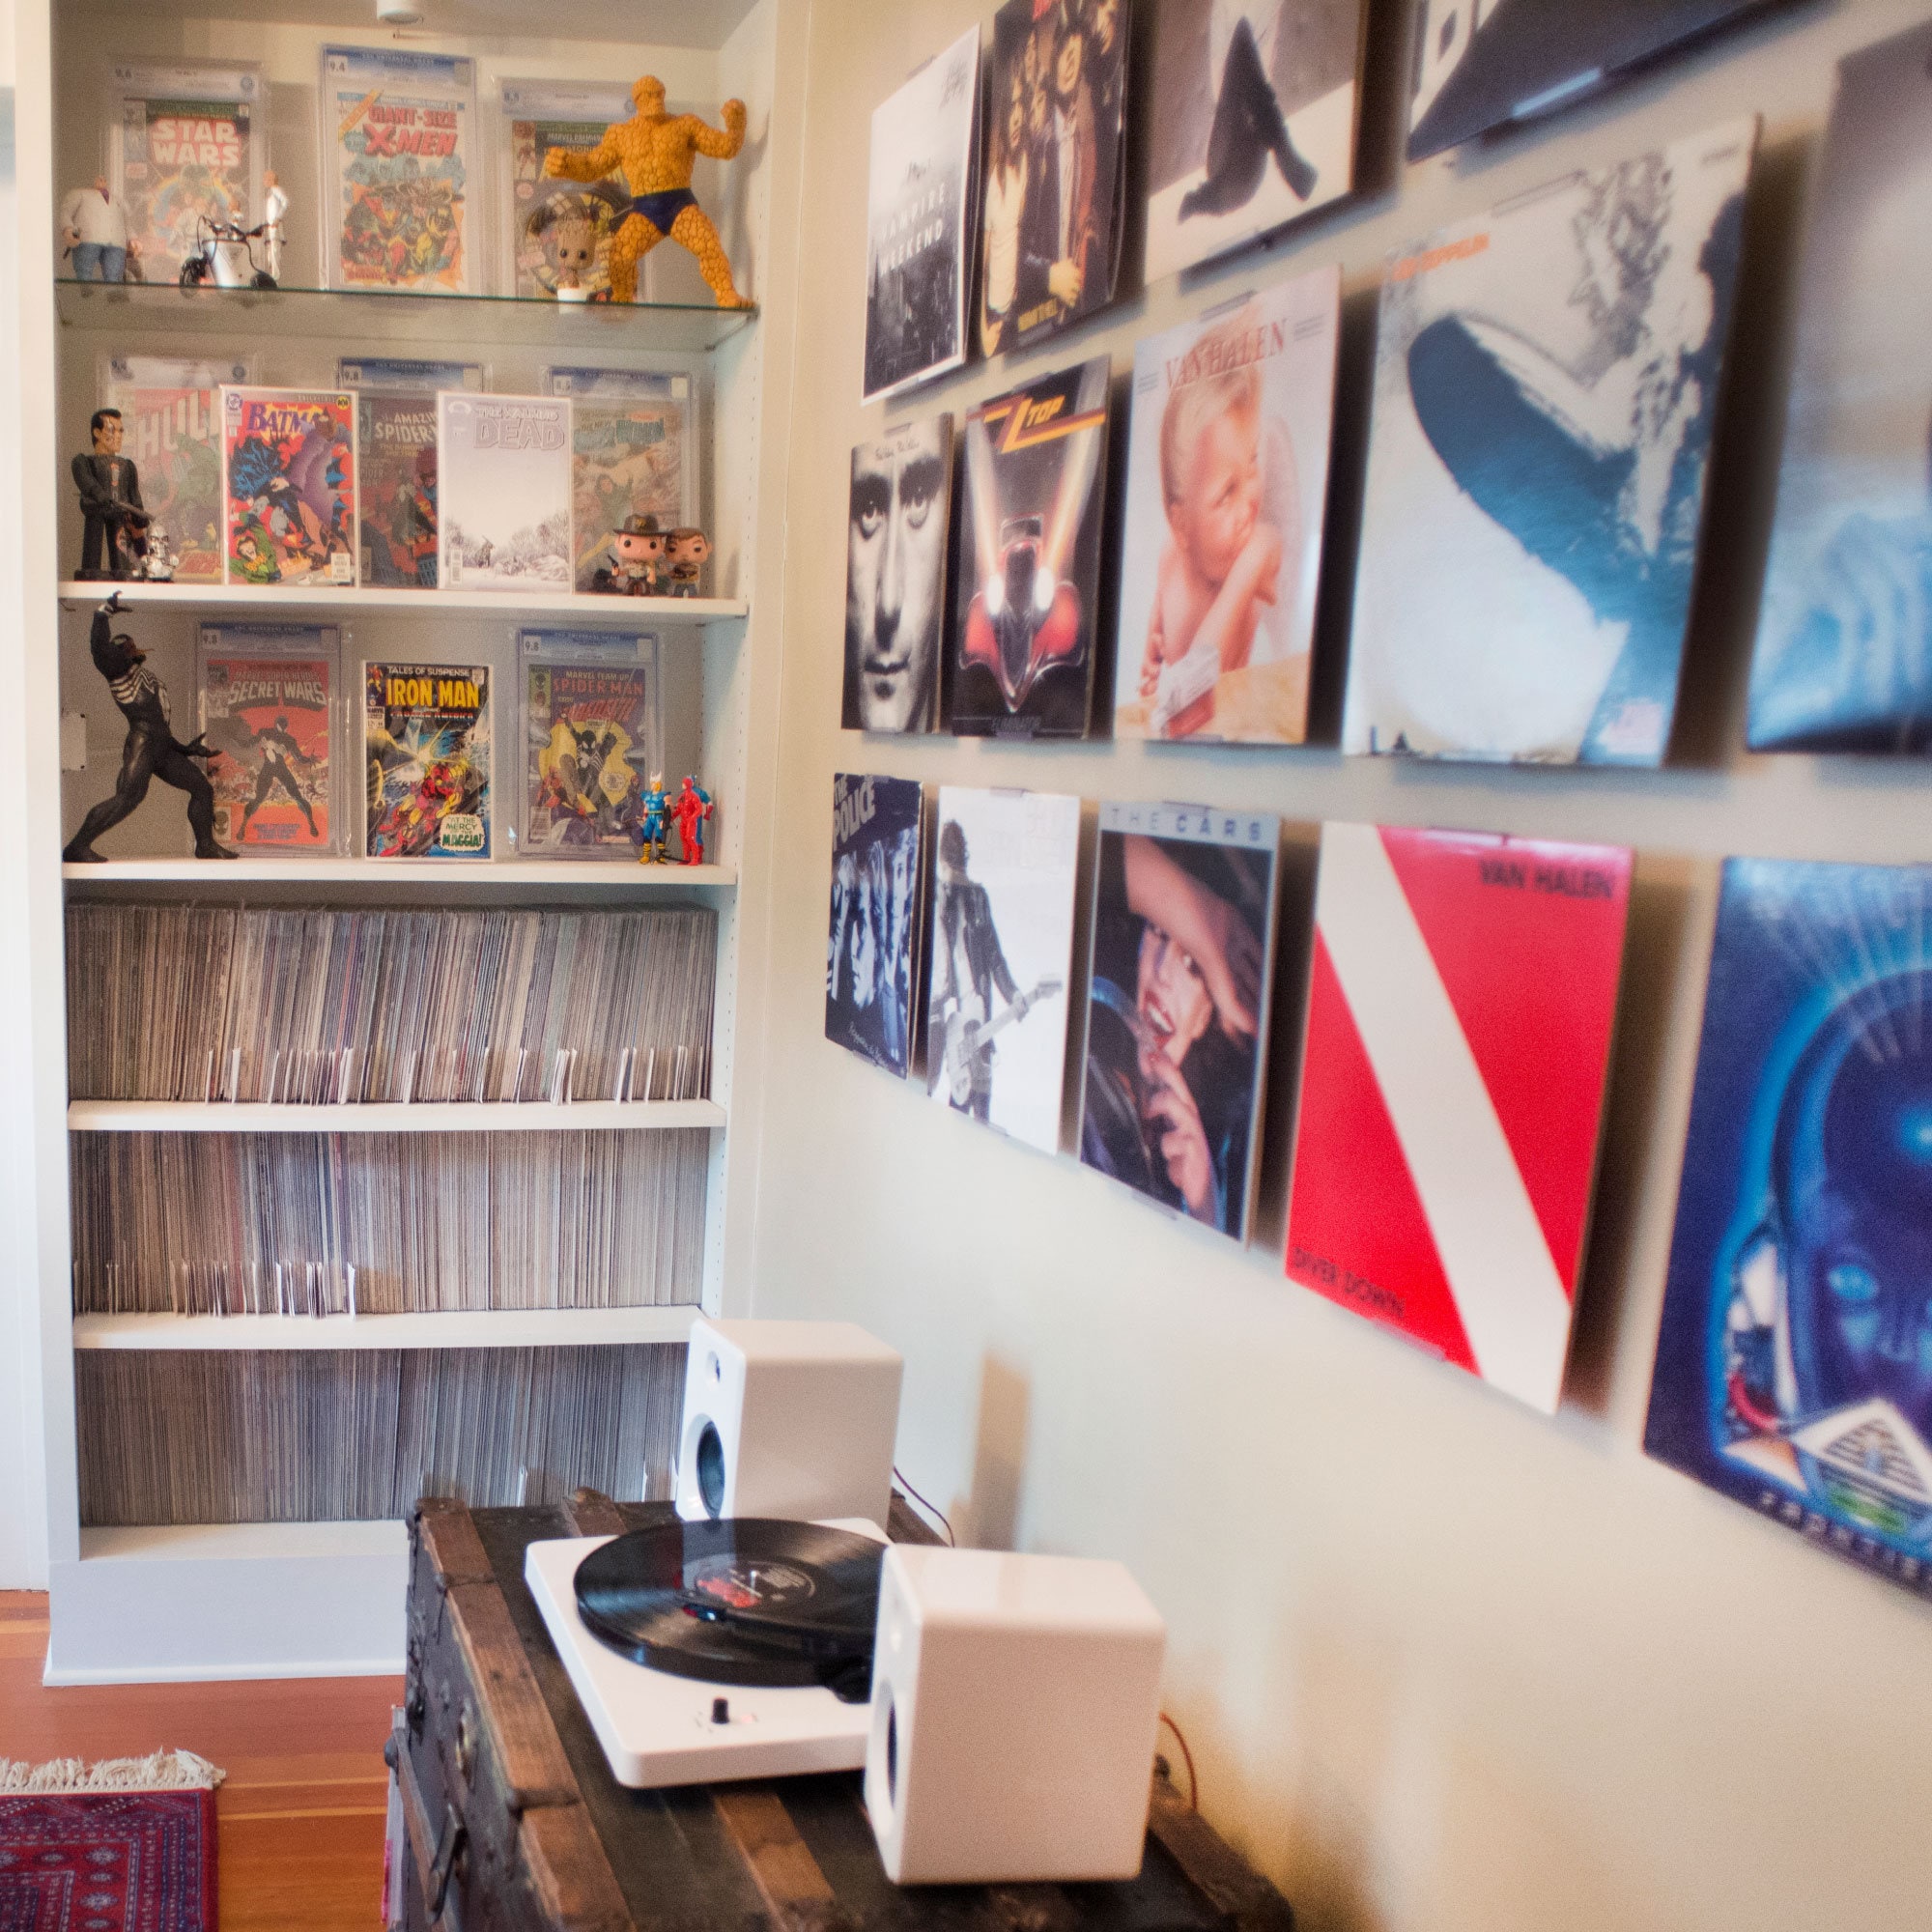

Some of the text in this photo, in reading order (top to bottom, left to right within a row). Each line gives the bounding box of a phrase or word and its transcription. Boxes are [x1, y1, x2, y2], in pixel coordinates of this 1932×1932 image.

[368, 104, 457, 129] GIANT-SIZE
[152, 119, 239, 143] STAR
[363, 124, 458, 157] X-MEN
[152, 142, 240, 166] WARS
[881, 183, 945, 239] VAMPIRE
[880, 218, 944, 277] WEEKEND
[393, 411, 438, 424] AMAZIN
[477, 406, 502, 418] THE
[1026, 394, 1065, 428] TOP
[374, 421, 438, 443] SPIDER-
[473, 416, 566, 451] DEAD
[525, 640, 539, 652] 9.8
[386, 666, 469, 677] TALES OF SUSPENSE
[228, 681, 327, 705] SECRET WARS
[386, 678, 479, 707] IRON MAN
[553, 678, 607, 693] SPIDER
[1111, 808, 1262, 842] THE CARS
[1479, 859, 1614, 899] VAN HALEN
[1293, 1246, 1406, 1319] DIVER DOWN
